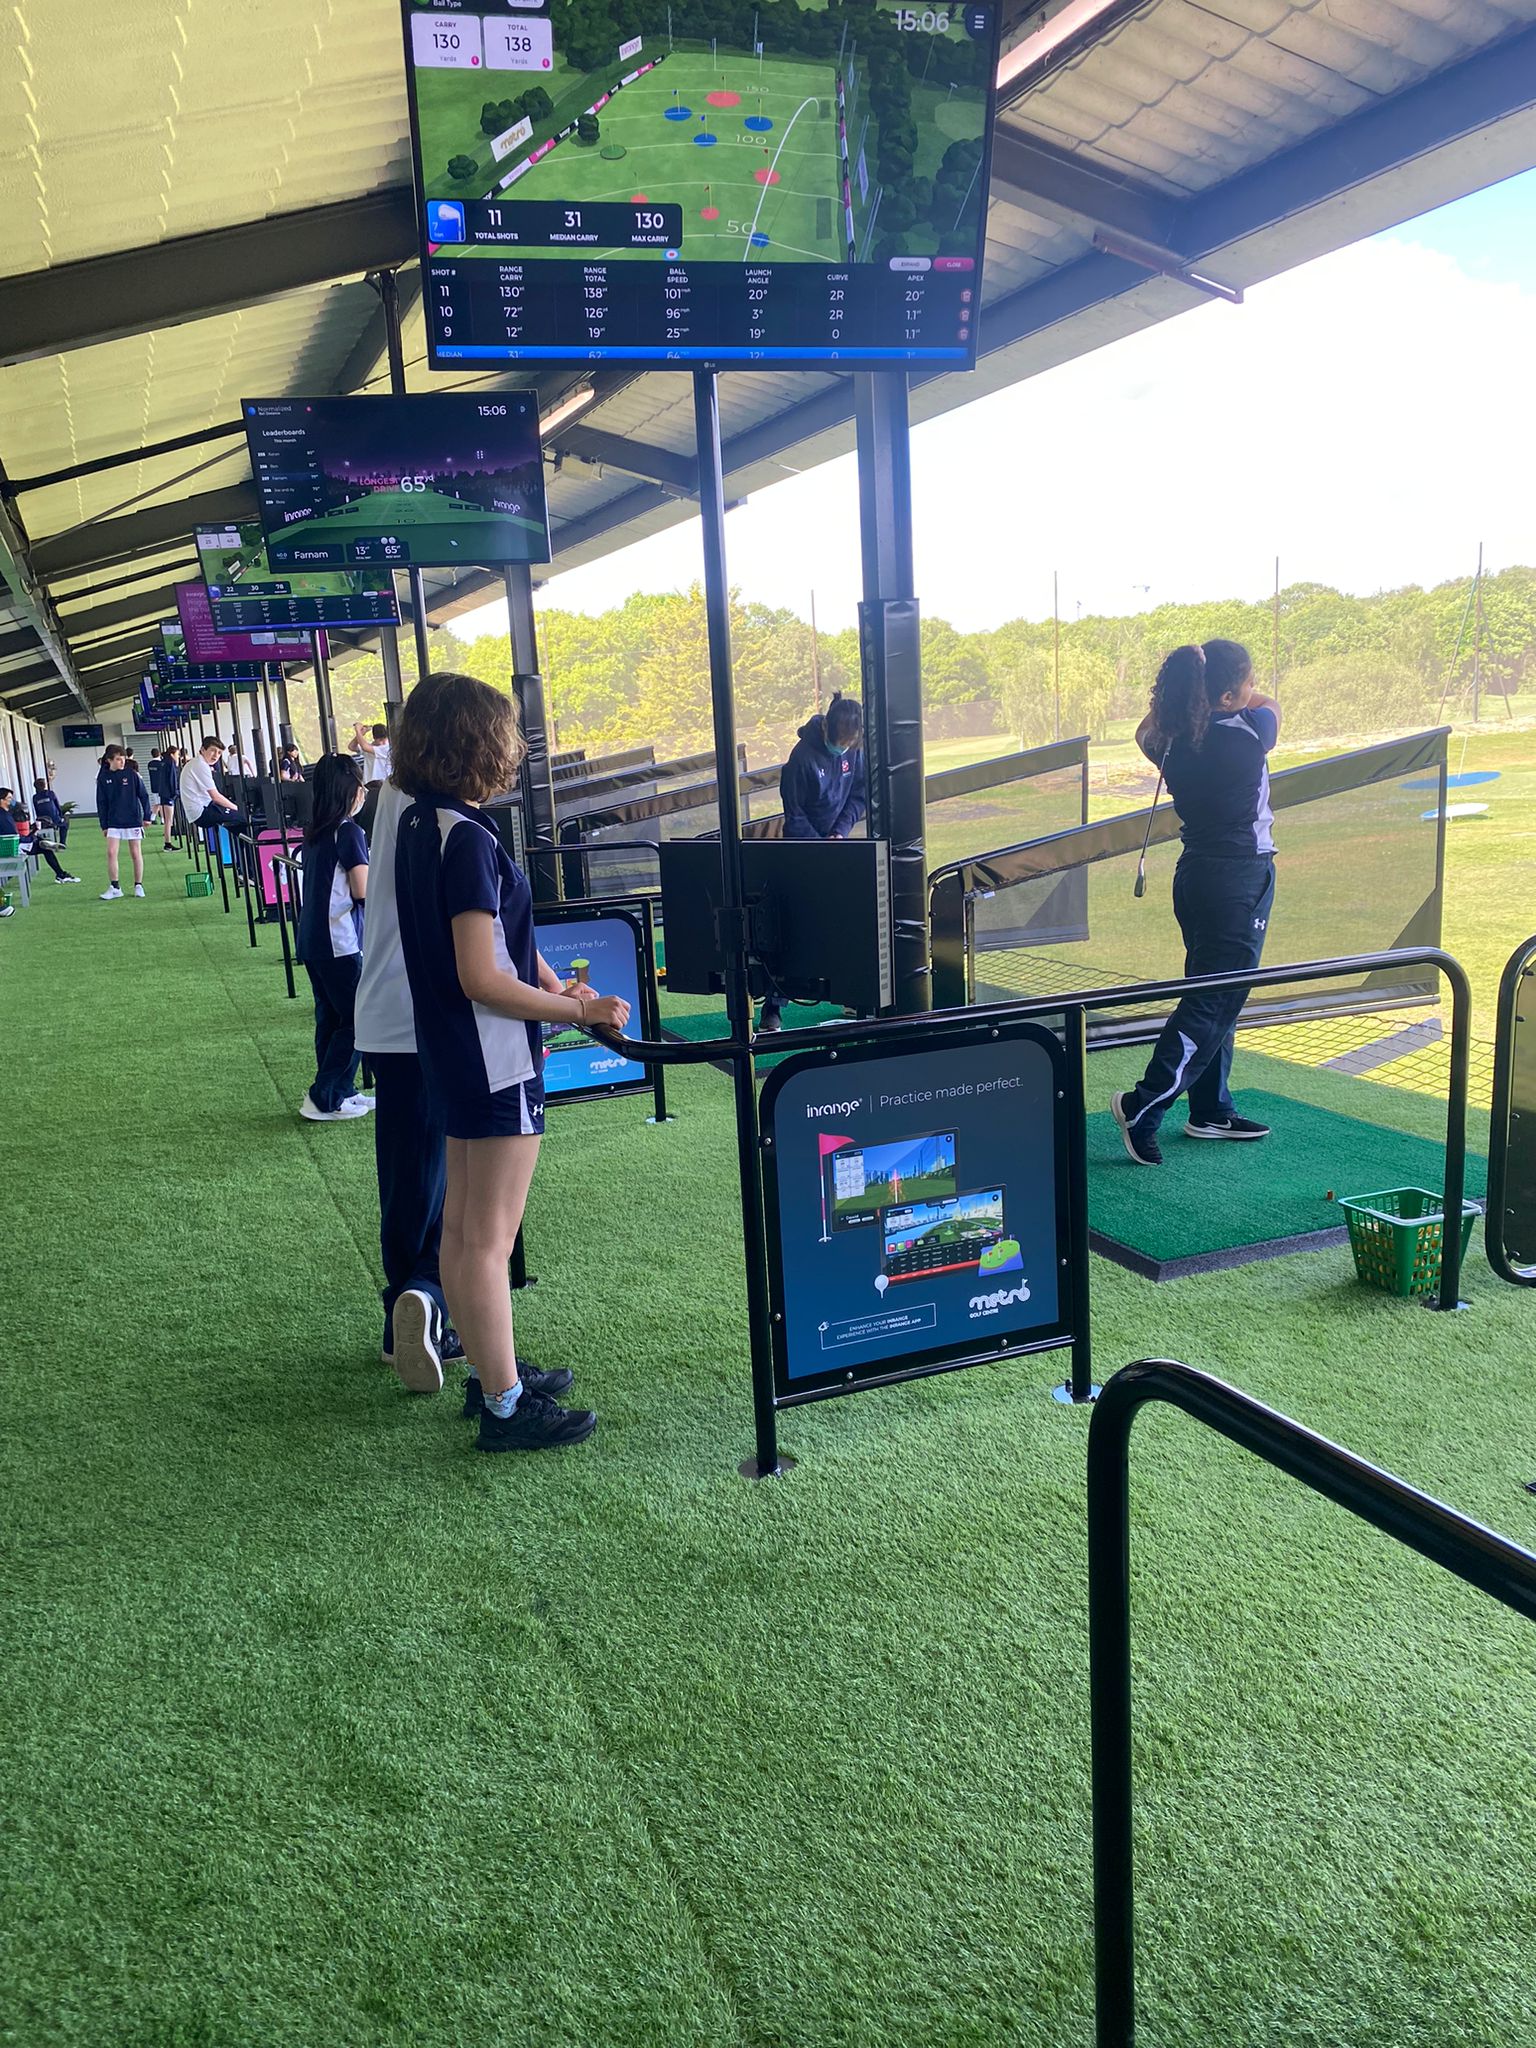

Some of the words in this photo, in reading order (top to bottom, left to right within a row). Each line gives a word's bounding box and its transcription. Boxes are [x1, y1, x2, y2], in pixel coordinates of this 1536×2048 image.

[895, 9, 949, 32] 15:06
[433, 34, 460, 49] 130
[505, 37, 531, 52] 138
[736, 134, 767, 145] 100
[488, 209, 502, 226] 11
[565, 211, 581, 227] 31
[635, 213, 664, 229] 130
[726, 220, 757, 234] 50
[550, 233, 576, 241] MEDIAN
[576, 234, 598, 242] CARRY
[440, 285, 449, 297] 11
[830, 290, 844, 301] 2R
[440, 306, 453, 317] 10
[829, 310, 844, 320] 2R
[444, 326, 452, 337] 9
[478, 405, 507, 416] 15:06
[359, 477, 398, 486] LONGEST
[374, 485, 400, 493] DRIVE
[294, 551, 328, 560] Farnam
[543, 945, 554, 953] All
[555, 944, 578, 952] about
[580, 941, 593, 949] the
[880, 1090, 932, 1107] Practice
[936, 1084, 973, 1099] made
[976, 1076, 1023, 1095] perfect.
[969, 1278, 1031, 1310] metro
[849, 1323, 872, 1332] ENHANCE
[873, 1319, 887, 1327] YOUR
[836, 1330, 866, 1340] EXPERIENCE
[866, 1327, 879, 1335] WITH
